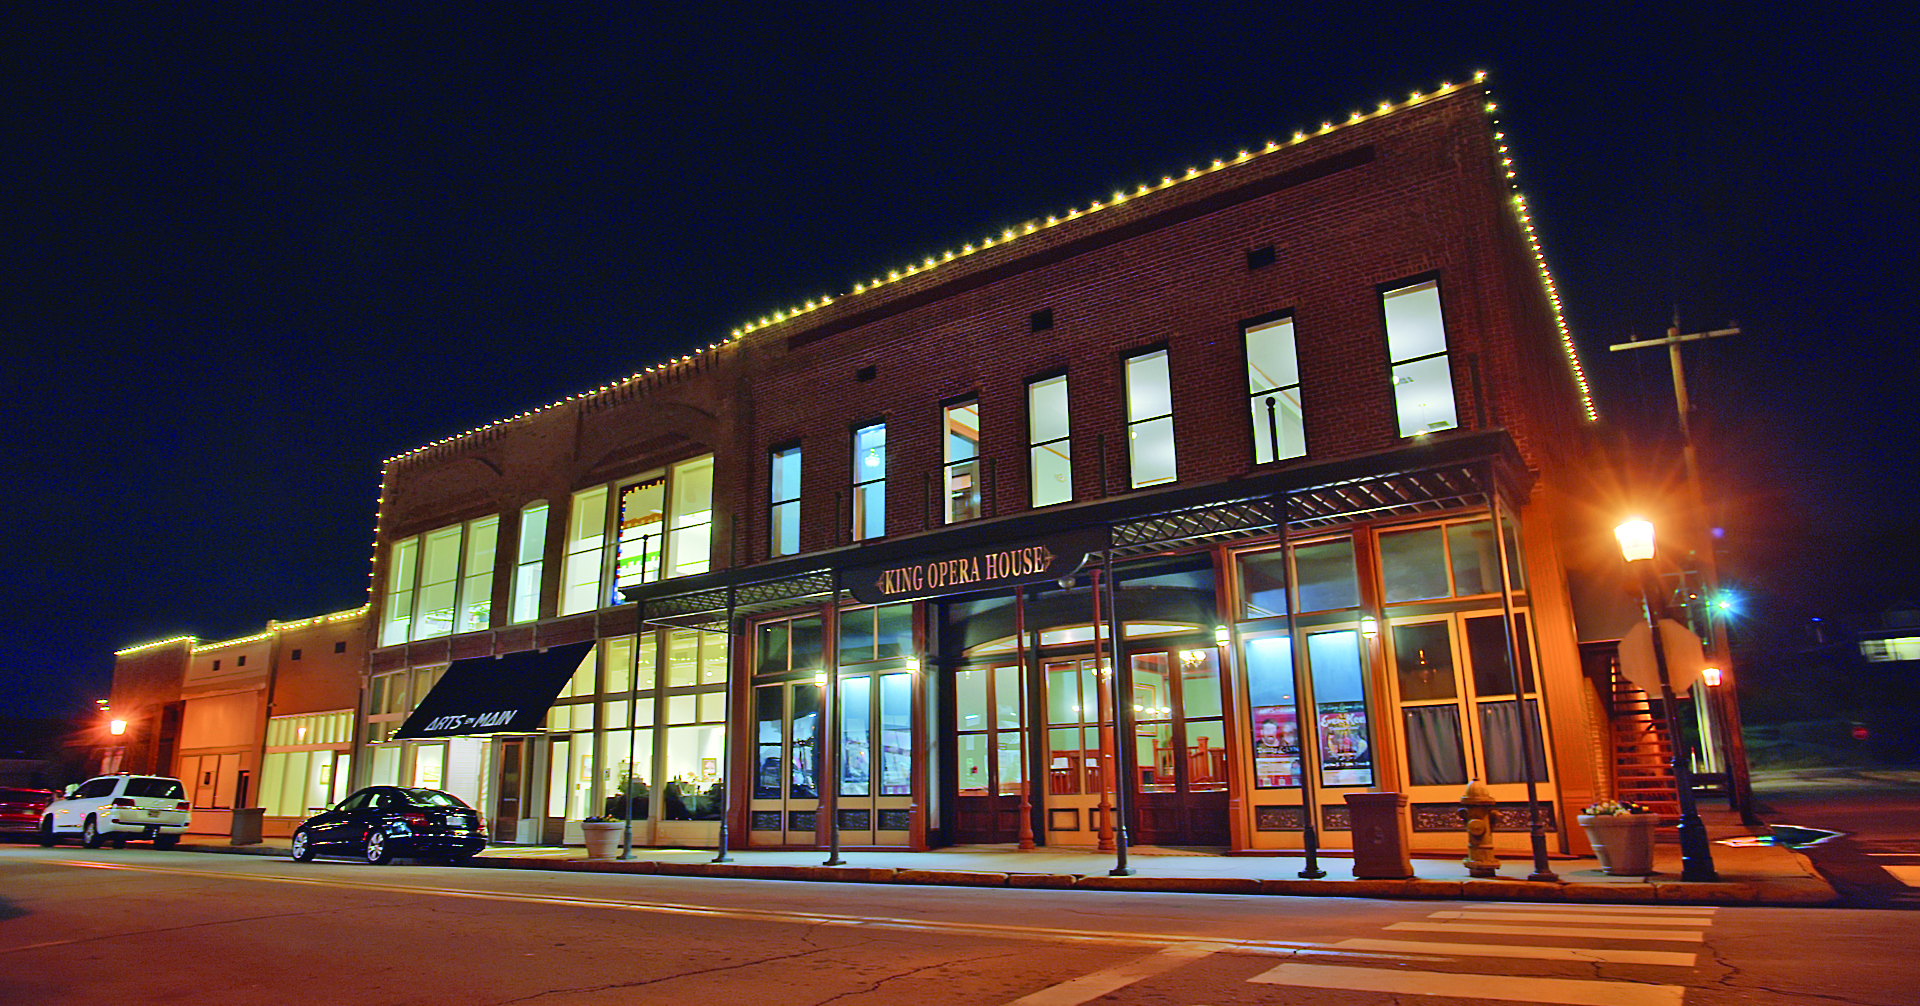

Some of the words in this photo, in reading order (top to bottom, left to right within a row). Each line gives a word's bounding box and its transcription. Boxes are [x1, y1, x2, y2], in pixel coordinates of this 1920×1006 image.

[884, 565, 923, 595] KING
[928, 556, 981, 589] OPERA
[985, 546, 1045, 580] HOUSE
[423, 714, 467, 731] ARTS
[472, 710, 518, 728] MAIN
